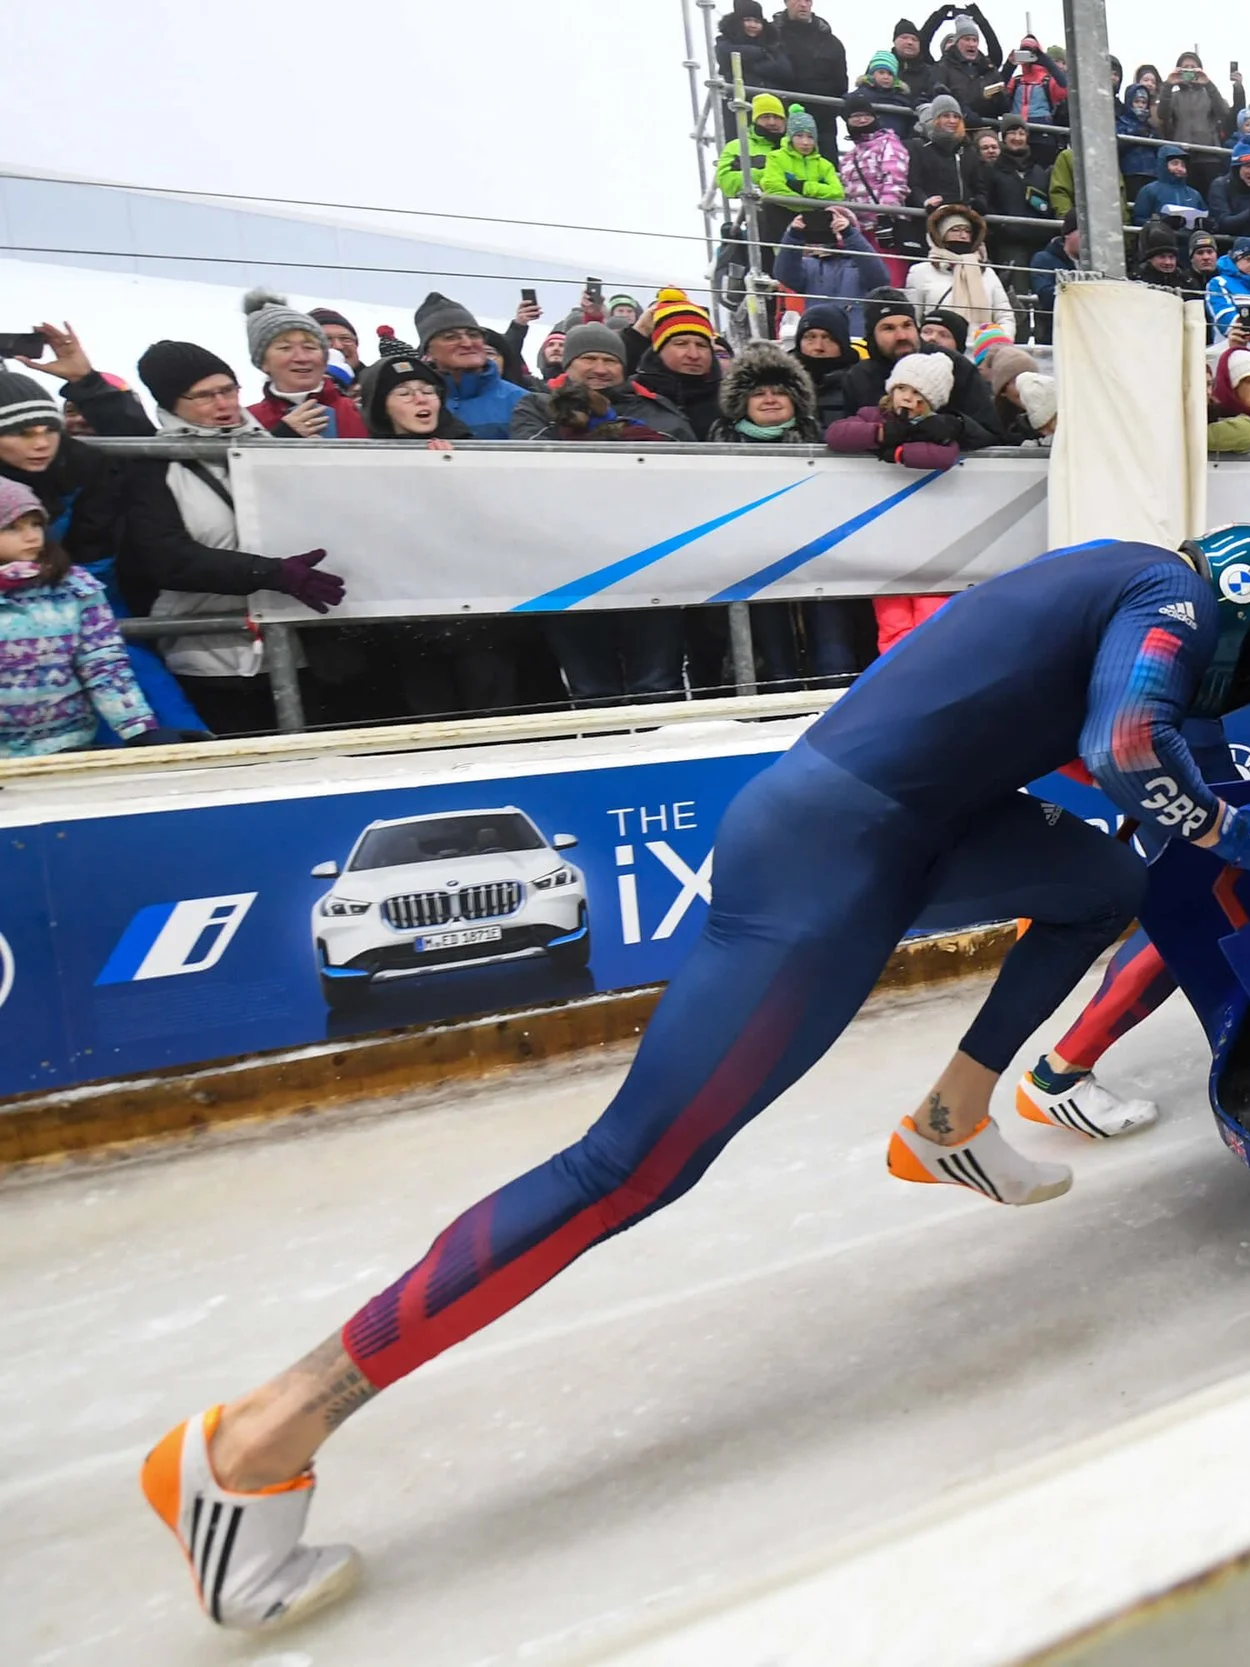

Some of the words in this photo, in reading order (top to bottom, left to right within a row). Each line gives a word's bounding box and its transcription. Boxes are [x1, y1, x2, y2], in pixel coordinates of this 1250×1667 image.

[1158, 606, 1198, 630] adidas
[606, 801, 698, 836] THE
[1140, 776, 1208, 837] GBR
[615, 840, 715, 945] iX
